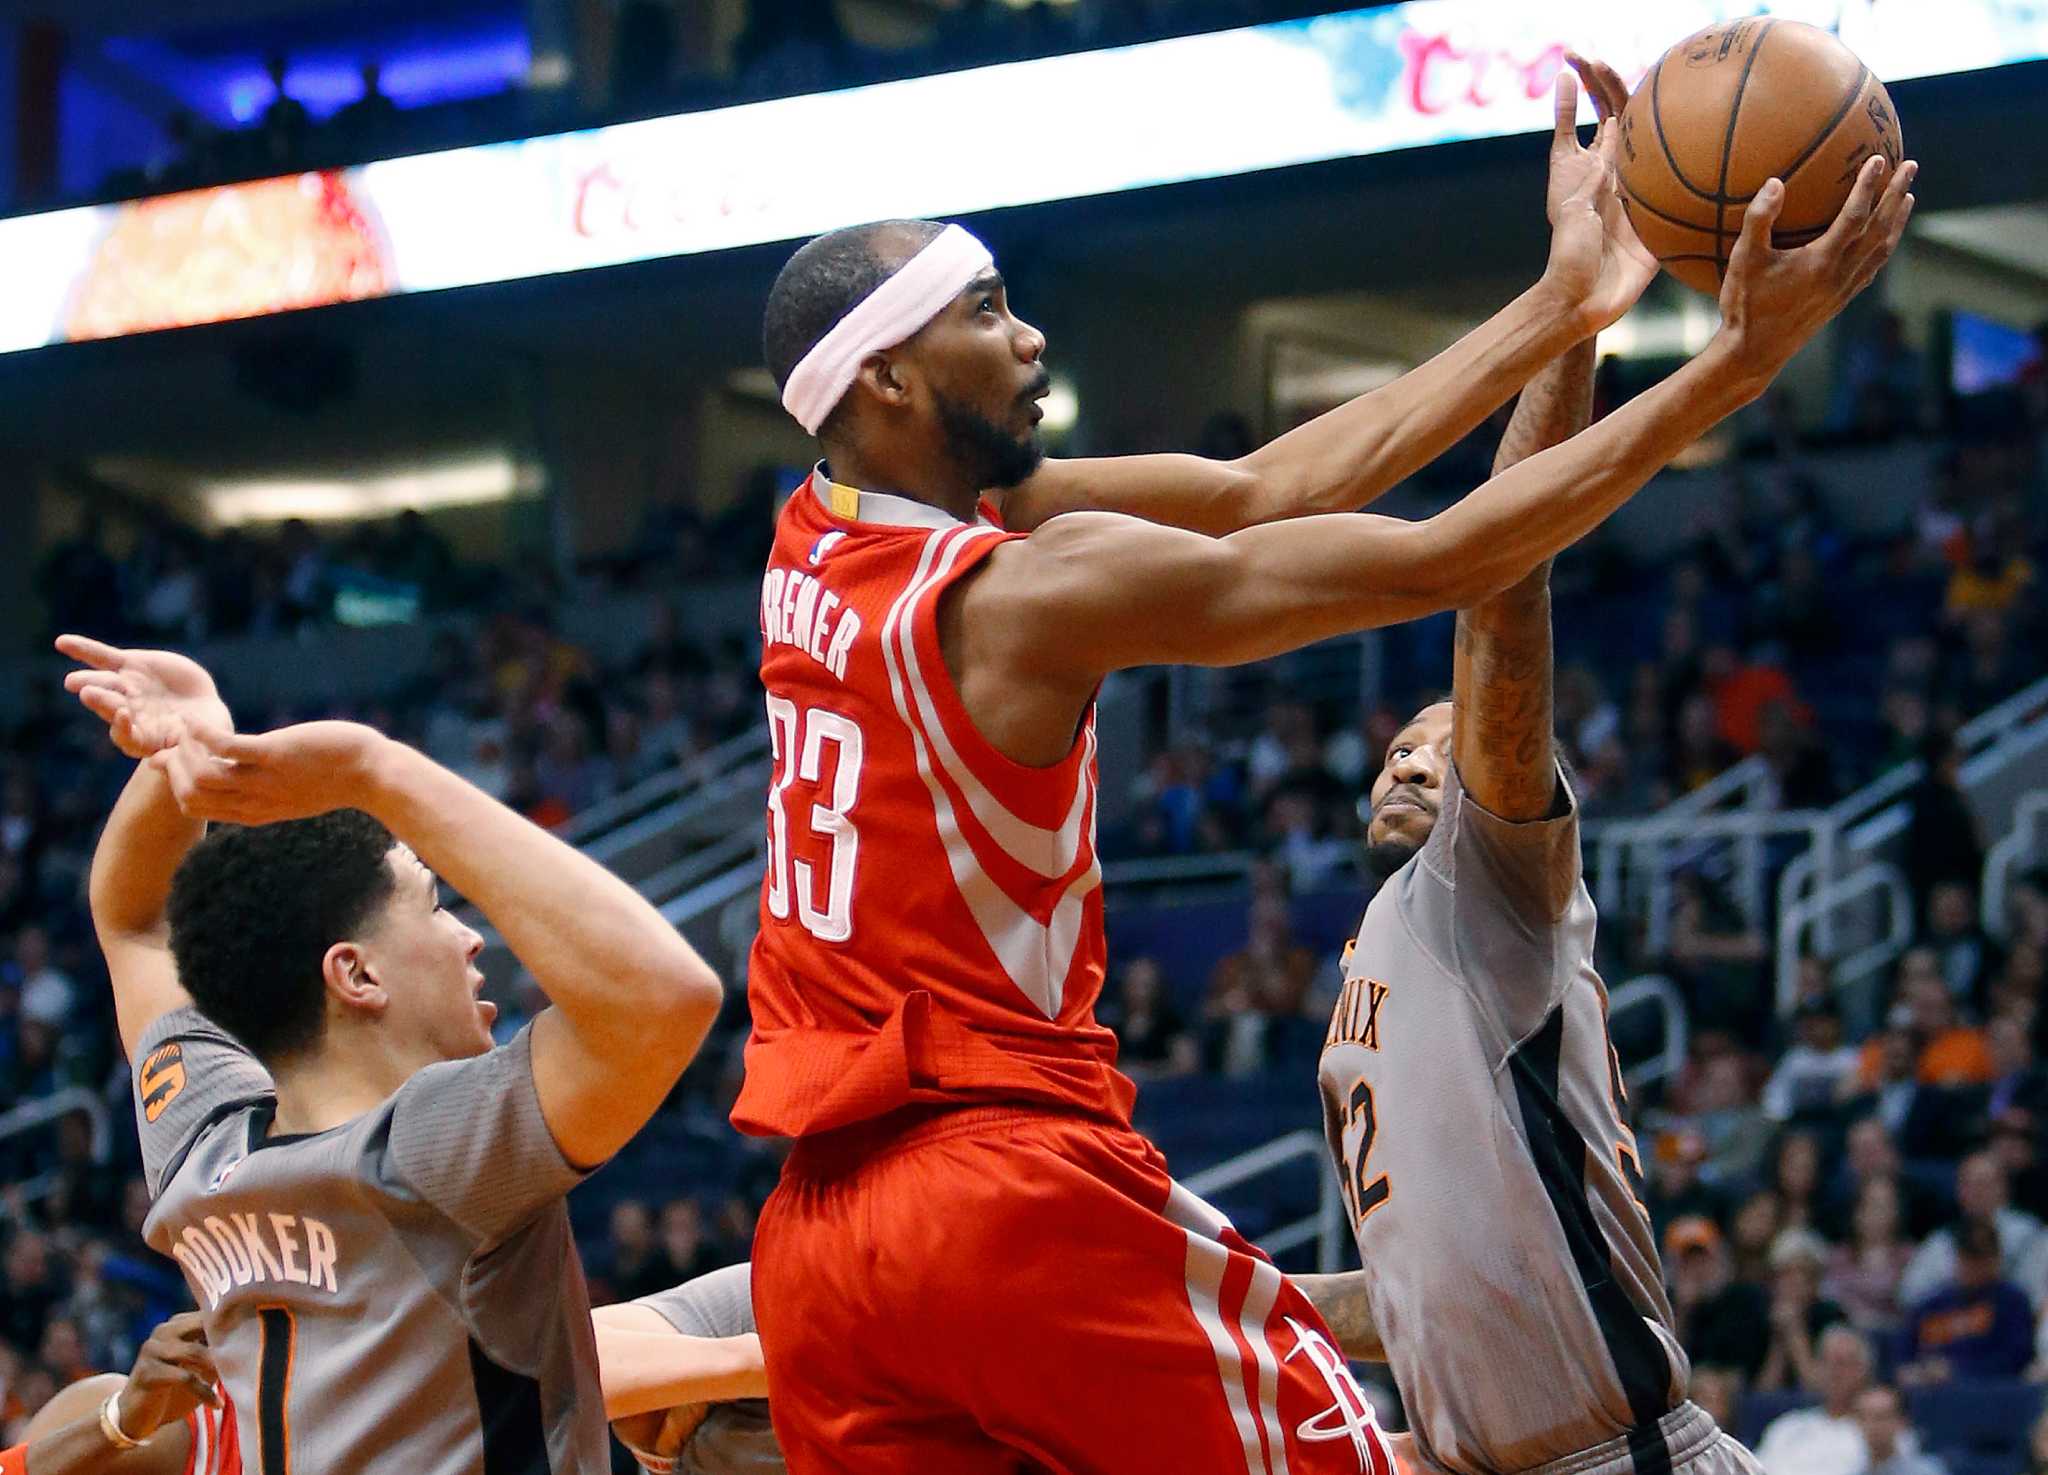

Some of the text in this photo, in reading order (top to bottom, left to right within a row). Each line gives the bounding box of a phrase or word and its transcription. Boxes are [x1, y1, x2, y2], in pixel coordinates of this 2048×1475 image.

[766, 689, 864, 944] 33
[173, 1212, 338, 1312] BOOKER
[255, 1303, 297, 1475] 1
